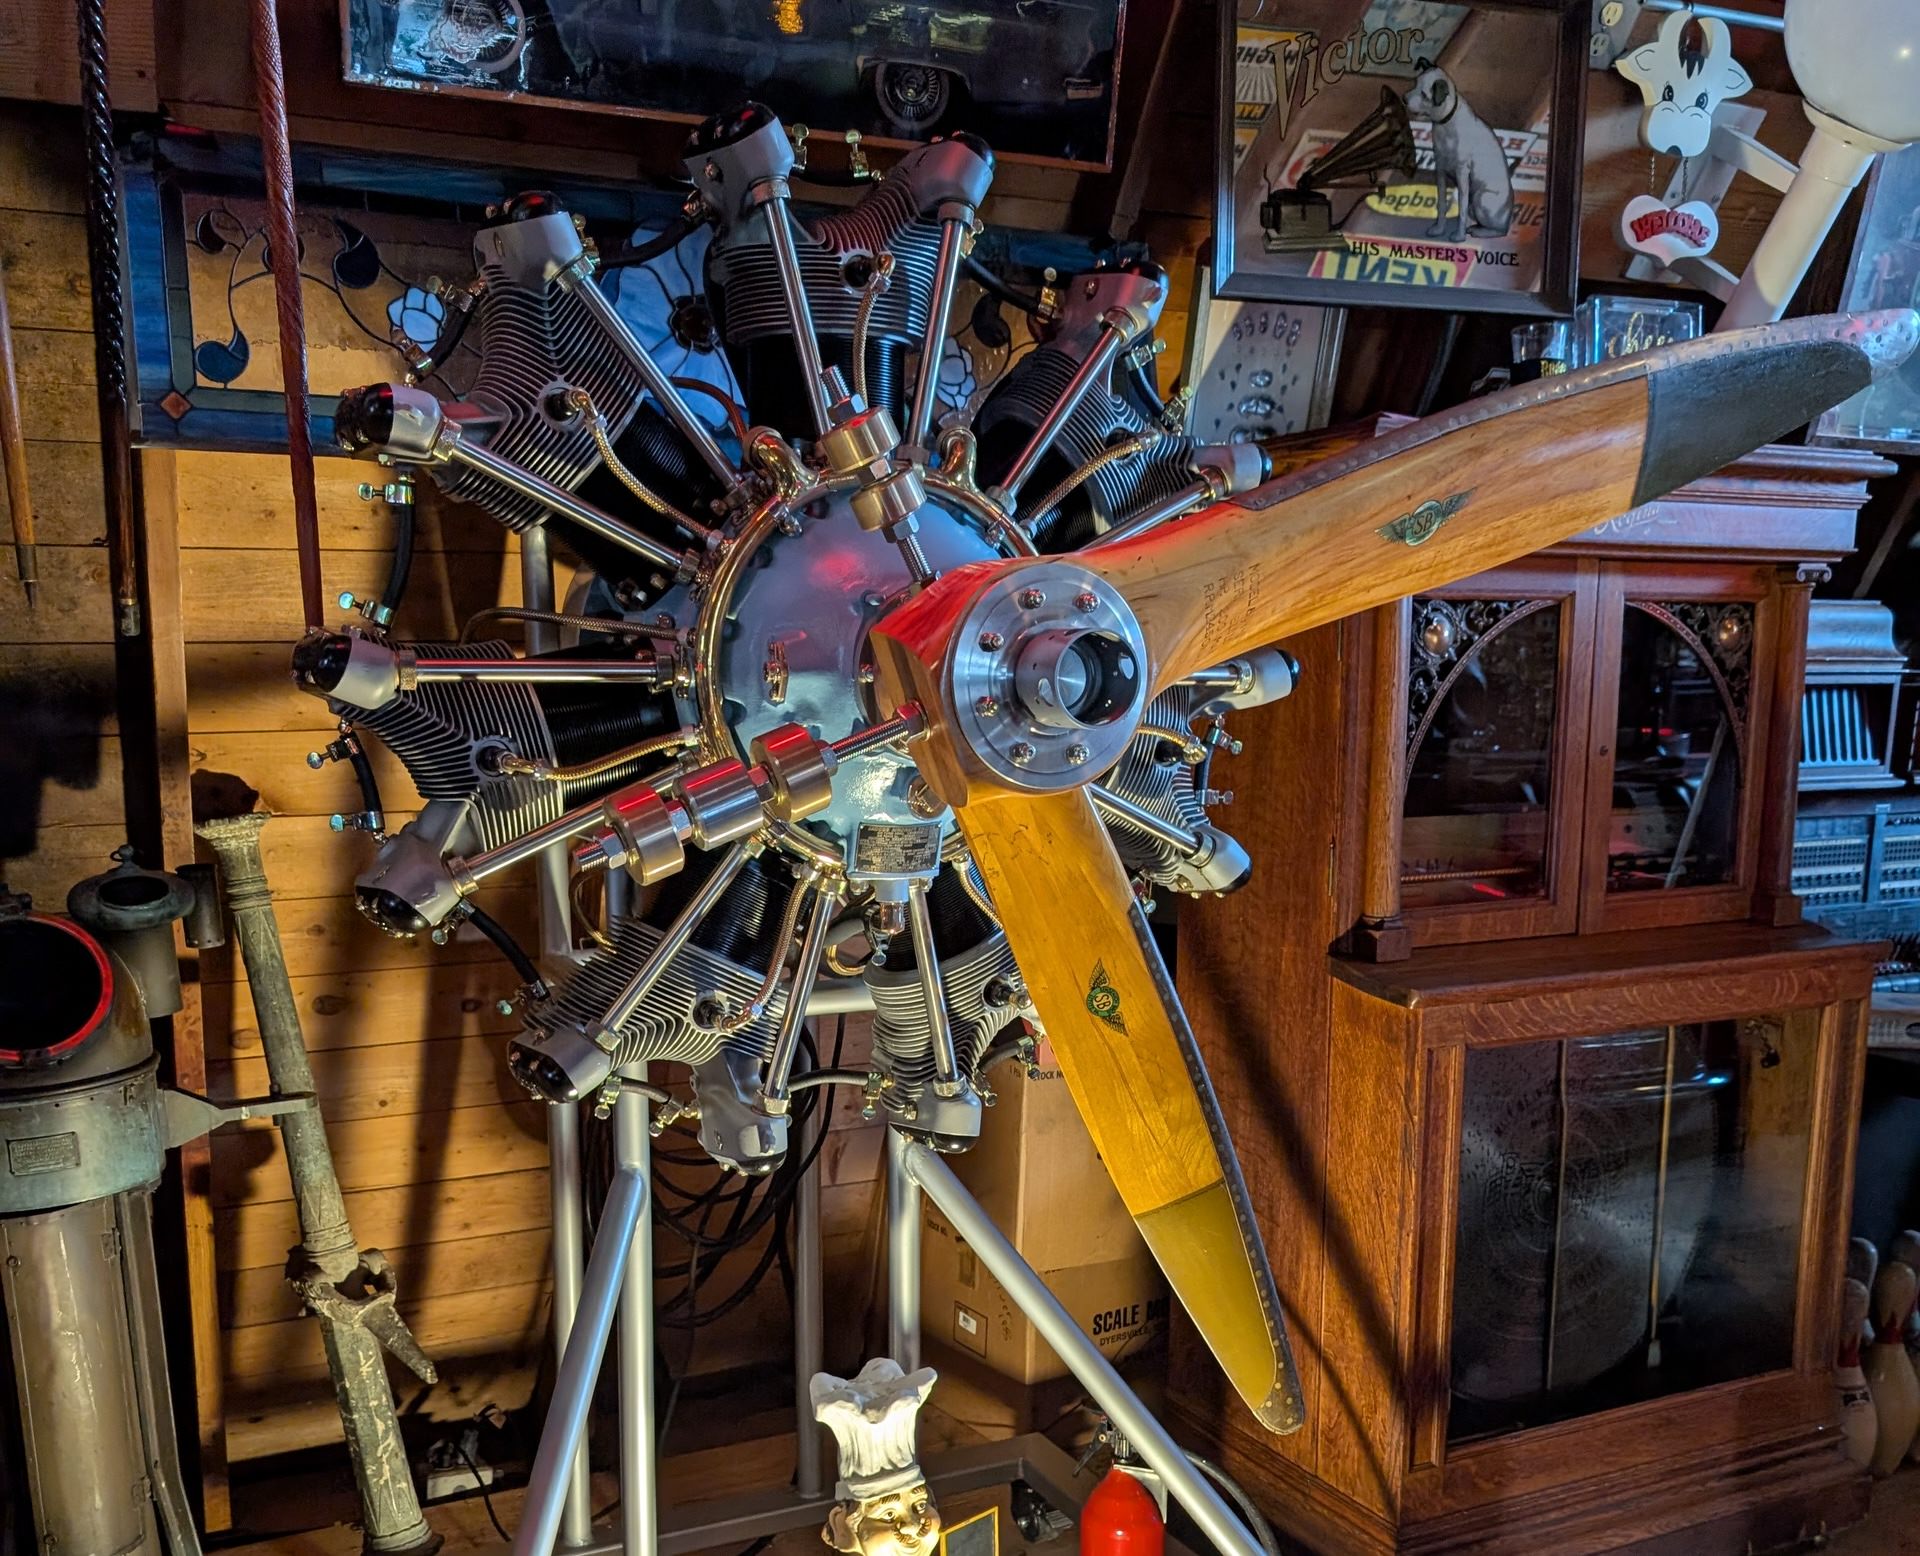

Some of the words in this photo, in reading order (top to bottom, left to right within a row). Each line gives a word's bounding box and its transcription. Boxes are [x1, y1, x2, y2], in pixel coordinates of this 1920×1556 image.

[1266, 19, 1425, 141] Victor
[1630, 208, 1711, 248] WELCOME
[1351, 240, 1380, 256] HIS
[1389, 244, 1469, 264] MASTER'S
[1475, 250, 1520, 267] VOICE
[1093, 1304, 1140, 1336] SCALE
